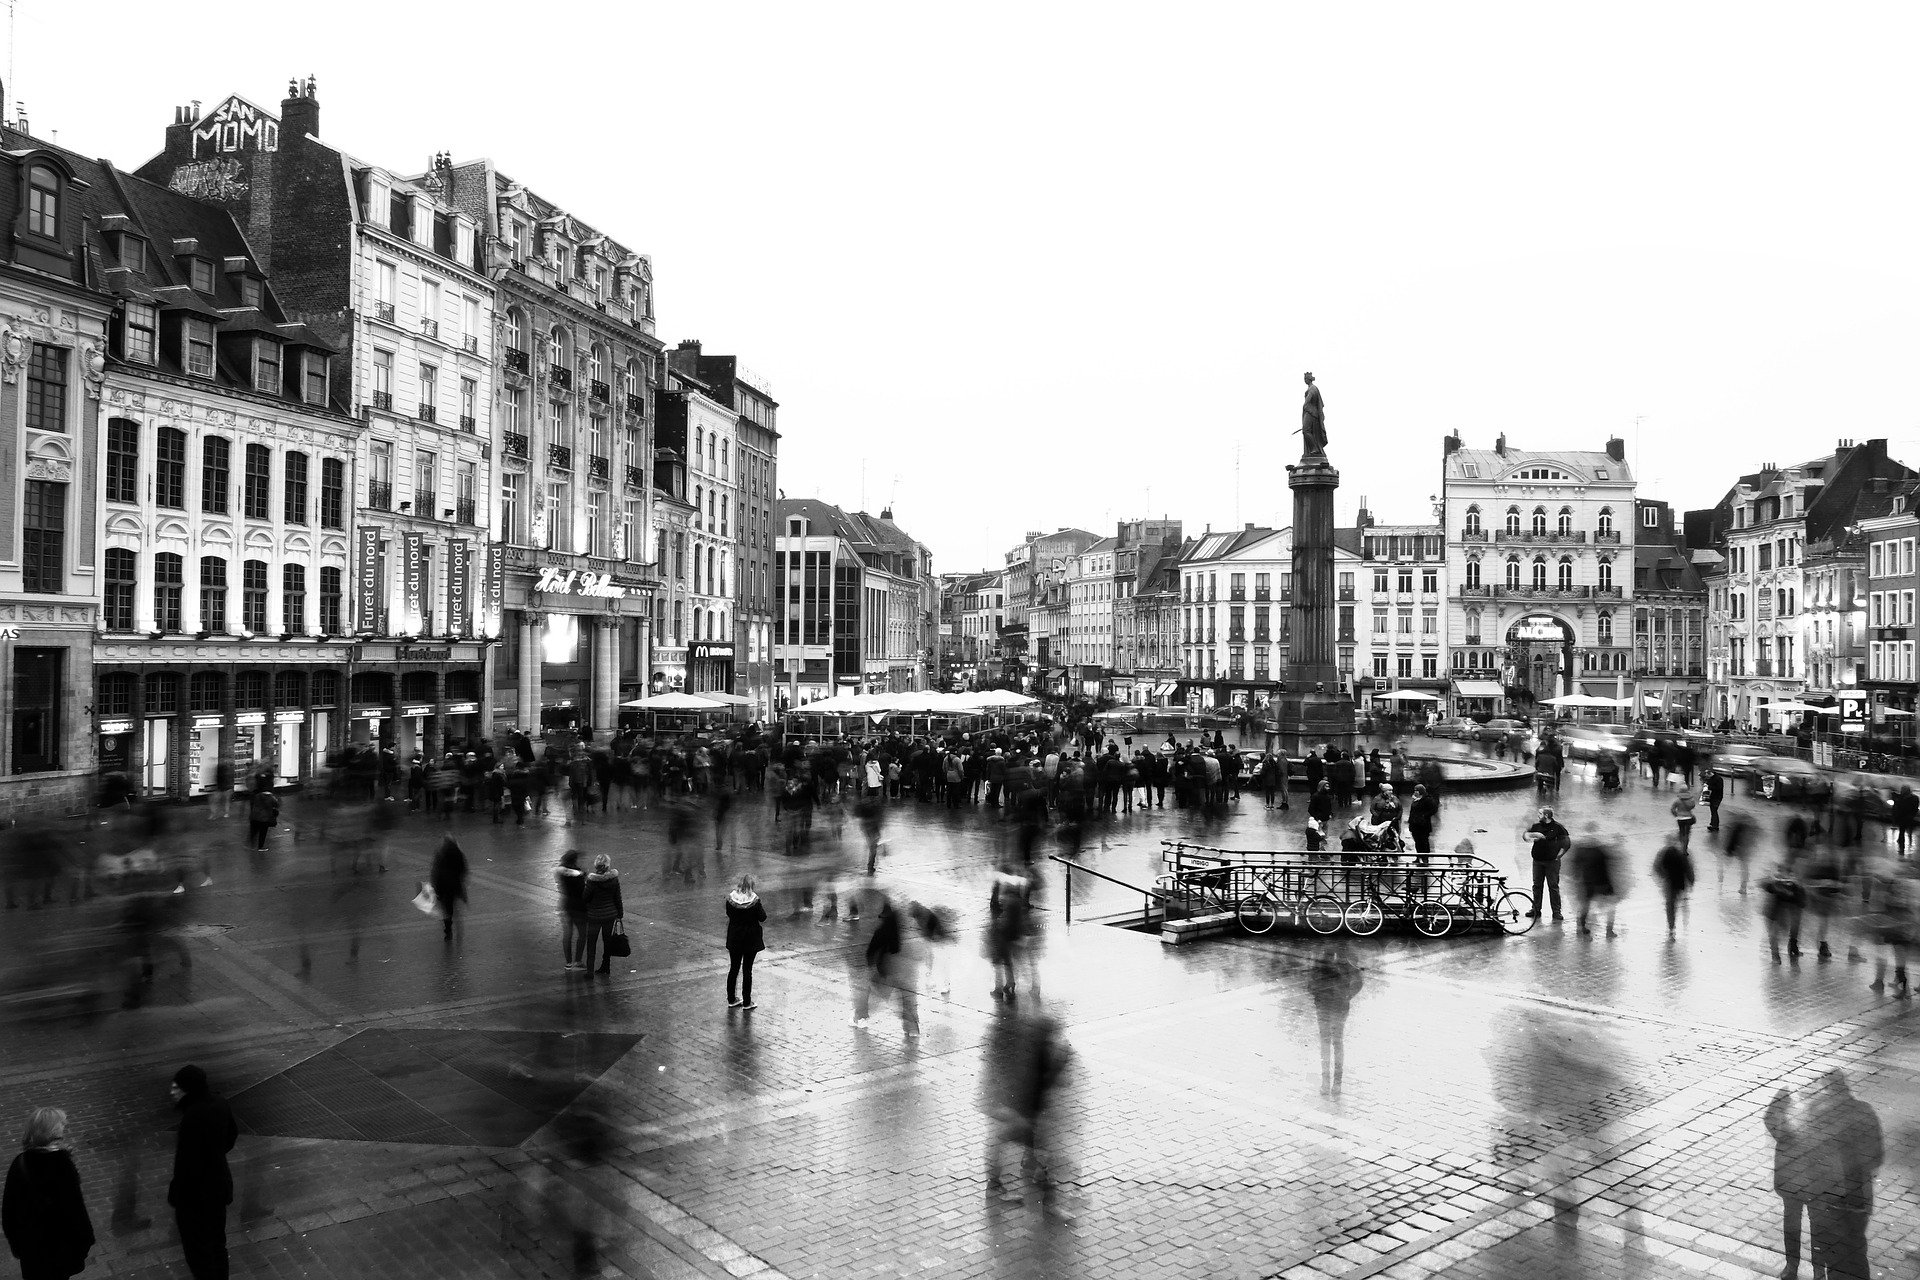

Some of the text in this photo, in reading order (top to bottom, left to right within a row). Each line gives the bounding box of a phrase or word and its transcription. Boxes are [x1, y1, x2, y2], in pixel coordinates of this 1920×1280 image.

[214, 98, 255, 122] SAN
[492, 548, 502, 578] nord
[362, 531, 376, 629] Furet du nord
[408, 536, 419, 622] uret du nord
[451, 543, 464, 634] Furet du nord
[490, 581, 500, 598] du
[1843, 699, 1859, 718] P
[1859, 760, 1867, 769] P
